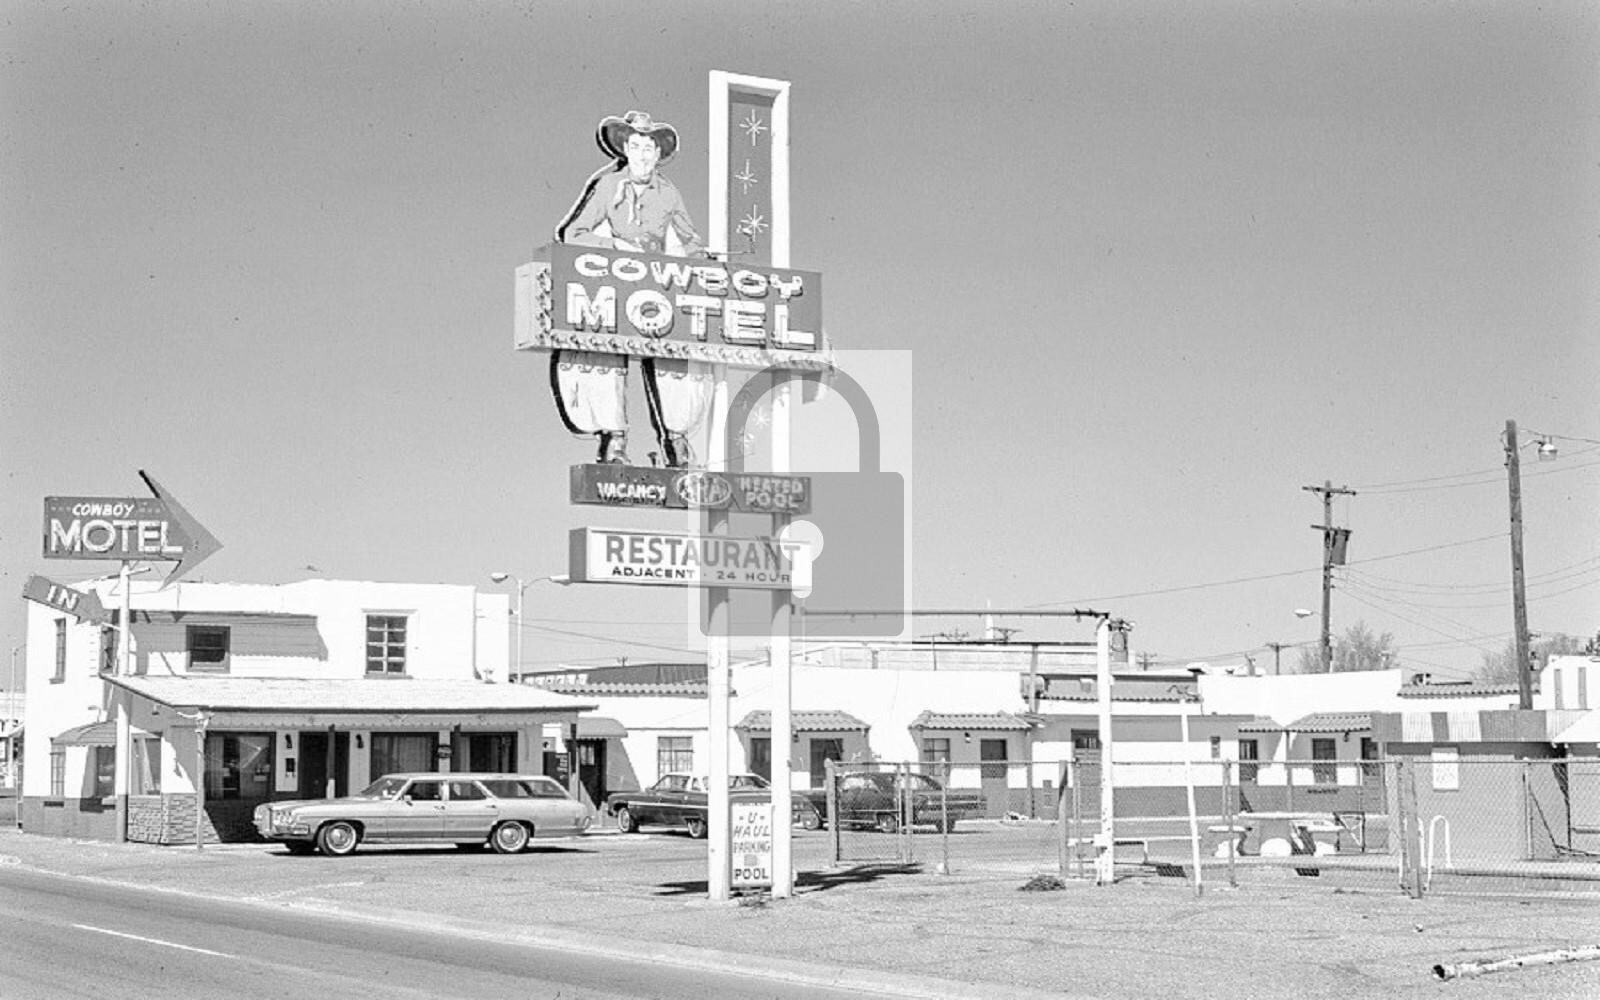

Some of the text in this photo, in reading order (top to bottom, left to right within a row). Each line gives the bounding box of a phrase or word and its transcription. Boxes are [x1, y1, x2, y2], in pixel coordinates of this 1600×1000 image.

[574, 253, 803, 299] COWBOY
[566, 281, 816, 350] MOTEL
[596, 482, 667, 500] VACANCY
[739, 476, 804, 494] HEATED
[745, 491, 799, 509] POOL
[72, 503, 135, 518] COWBOY
[50, 518, 183, 552] MOTEL
[606, 535, 802, 571] RESTAURANT
[612, 565, 695, 578] ADJACENT
[716, 570, 737, 580] 24
[47, 585, 79, 610] IN
[733, 825, 771, 839] HAUL
[734, 867, 769, 880] POOL
